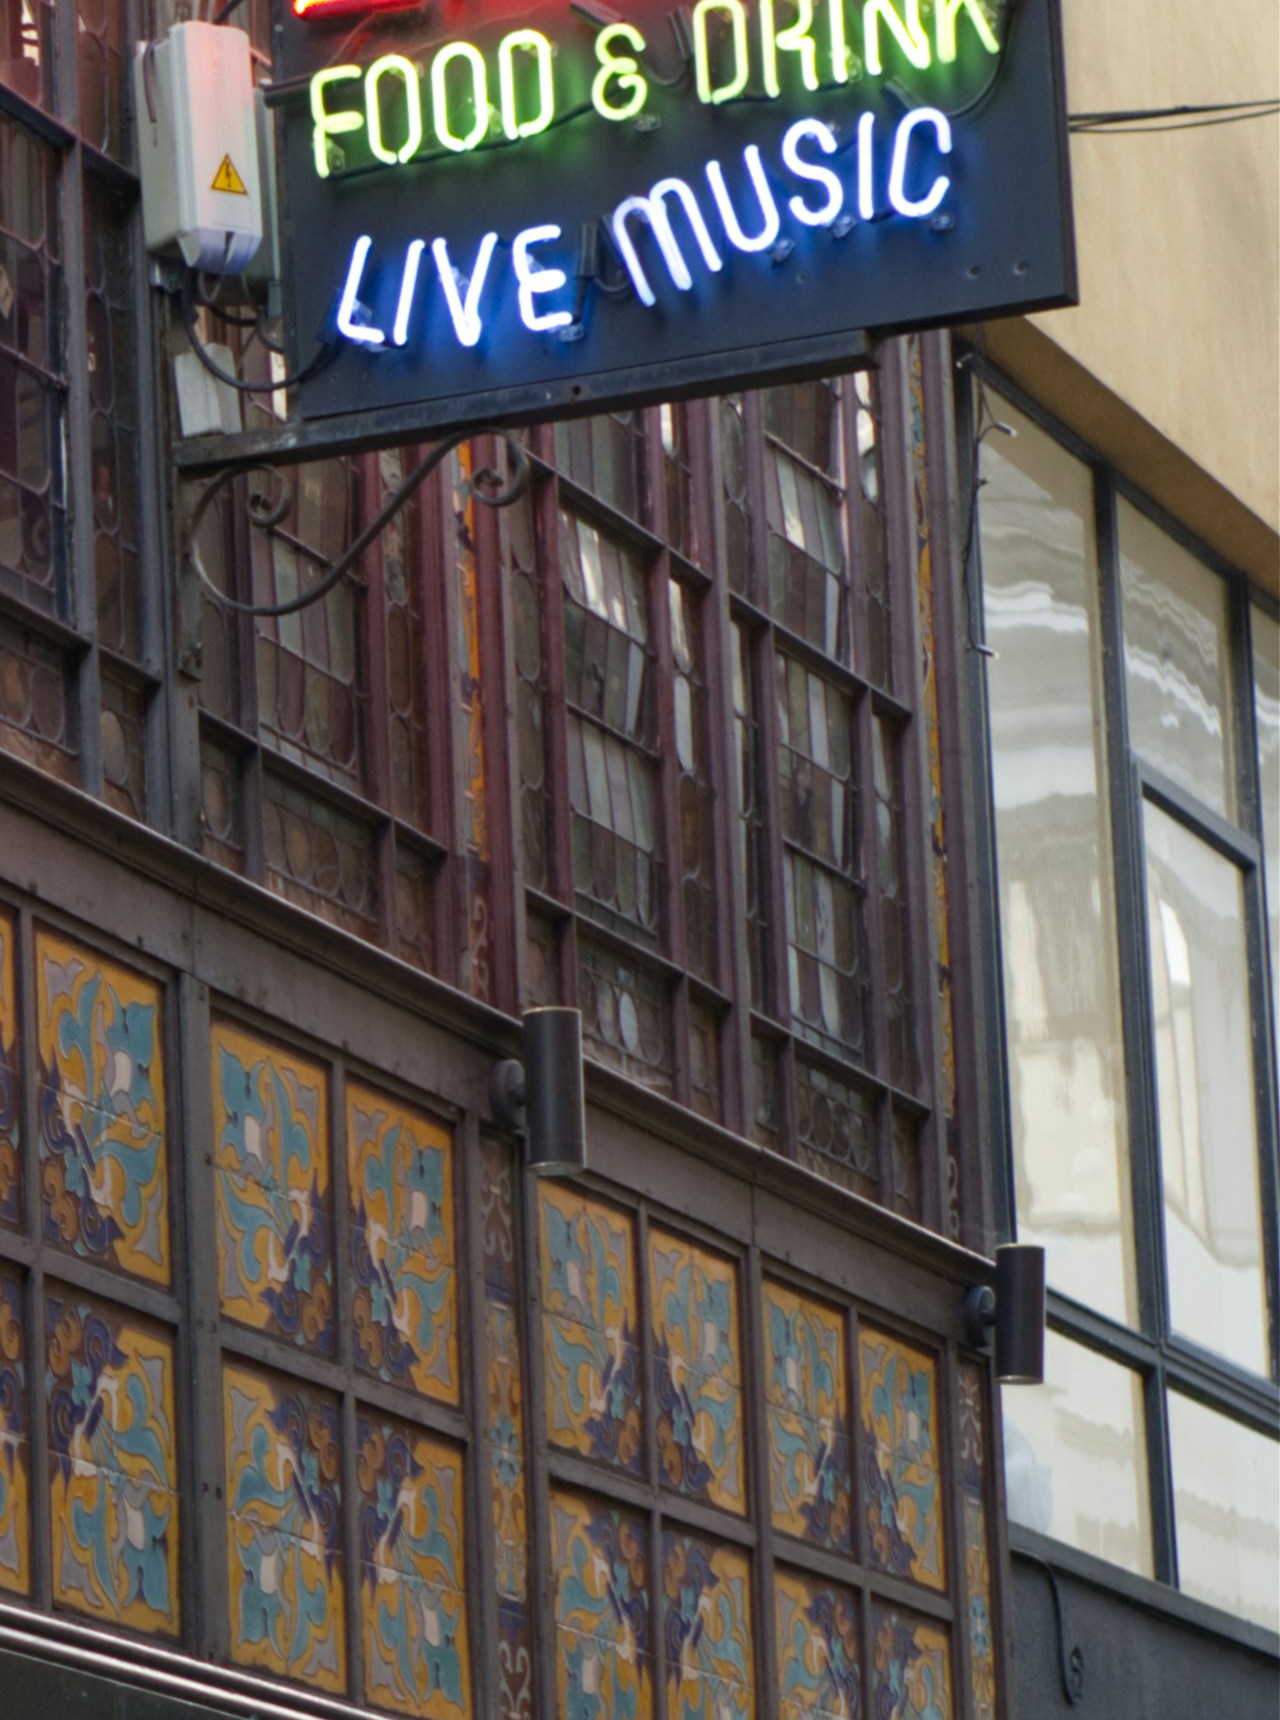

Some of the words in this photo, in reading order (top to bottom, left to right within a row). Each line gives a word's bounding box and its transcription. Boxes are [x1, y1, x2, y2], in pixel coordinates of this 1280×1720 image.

[310, 28, 553, 179] FOOD
[591, 23, 647, 120] &
[338, 224, 574, 346] LIVE
[612, 107, 953, 307] MUSIC
